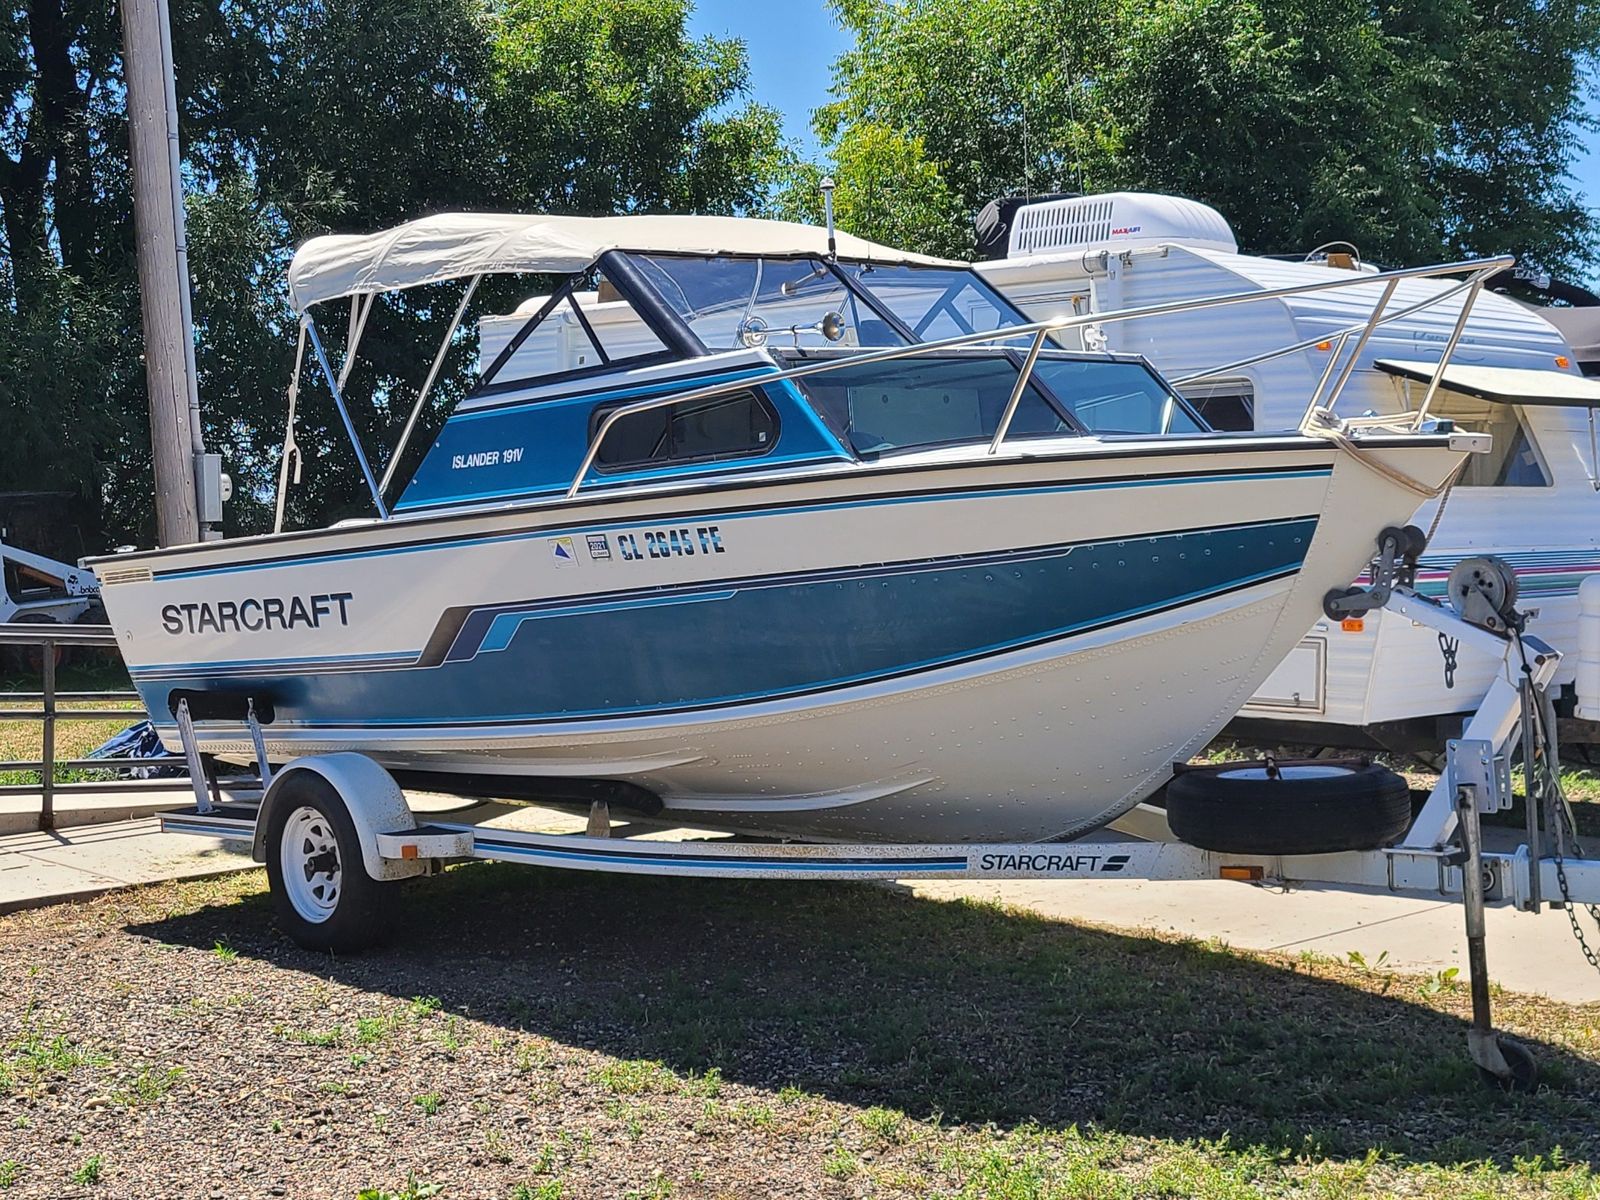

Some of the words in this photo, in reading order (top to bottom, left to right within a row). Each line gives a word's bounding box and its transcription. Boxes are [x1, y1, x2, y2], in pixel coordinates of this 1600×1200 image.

[452, 451, 500, 469] ISLANDER
[589, 542, 606, 550] 2021
[617, 533, 644, 560] CL
[644, 529, 695, 558] 2645
[696, 526, 725, 554] FE
[161, 592, 353, 635] STARCRAFT
[980, 853, 1102, 871] STARCRAFT
